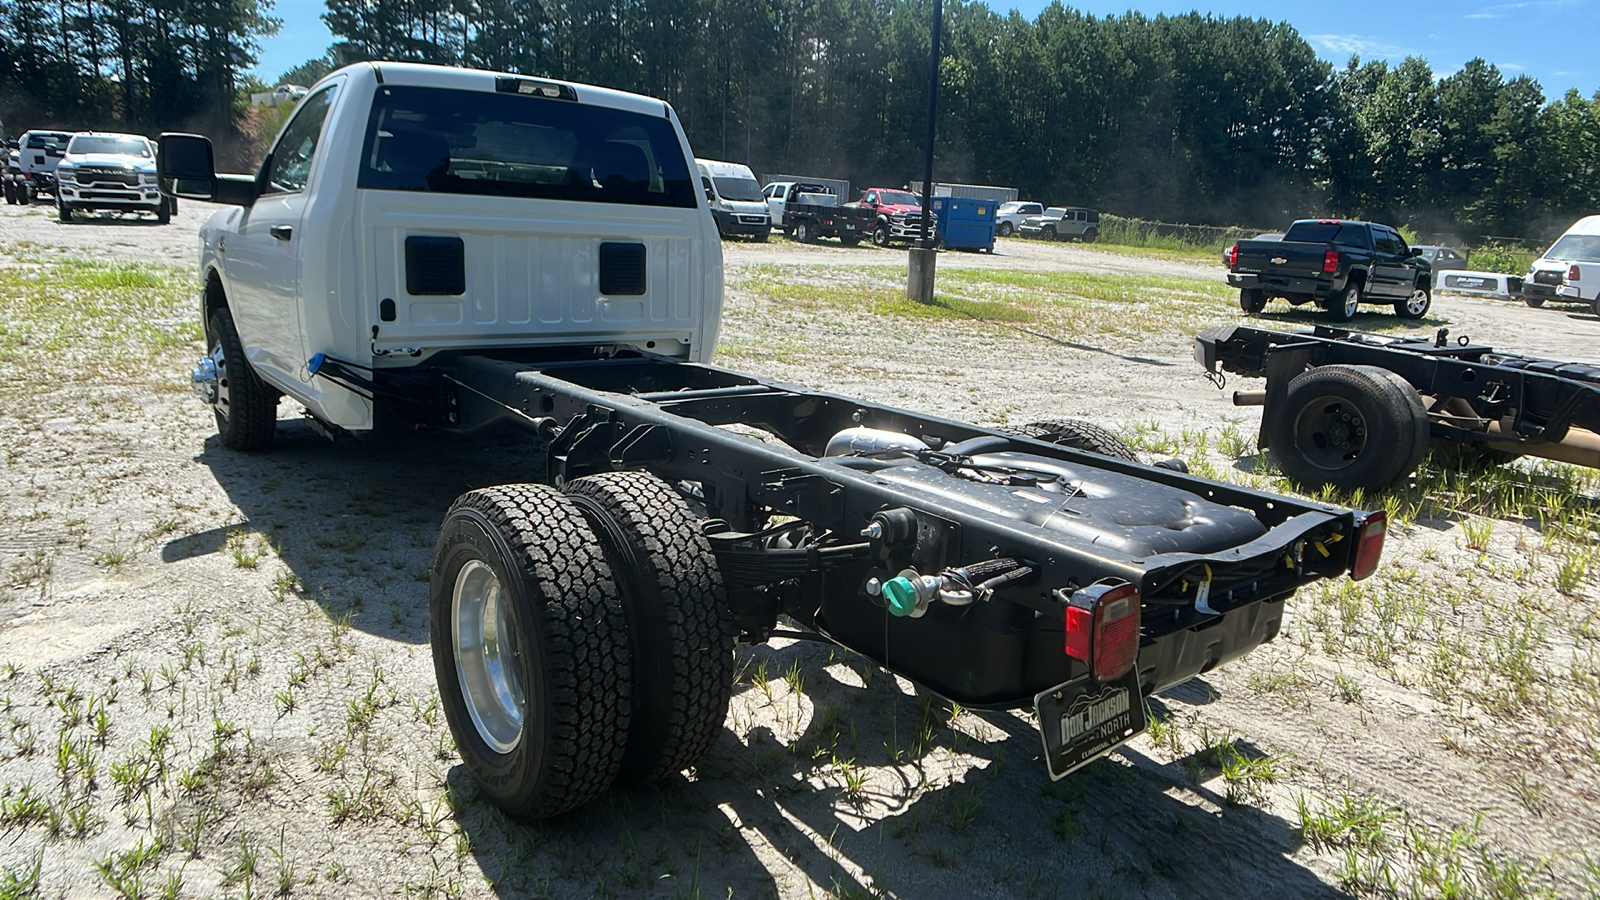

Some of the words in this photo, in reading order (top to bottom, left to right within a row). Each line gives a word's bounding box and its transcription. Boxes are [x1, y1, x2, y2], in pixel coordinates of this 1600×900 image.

[1060, 711, 1084, 746] DON
[1085, 690, 1130, 731] JACKSON
[1100, 712, 1130, 739] NORTH
